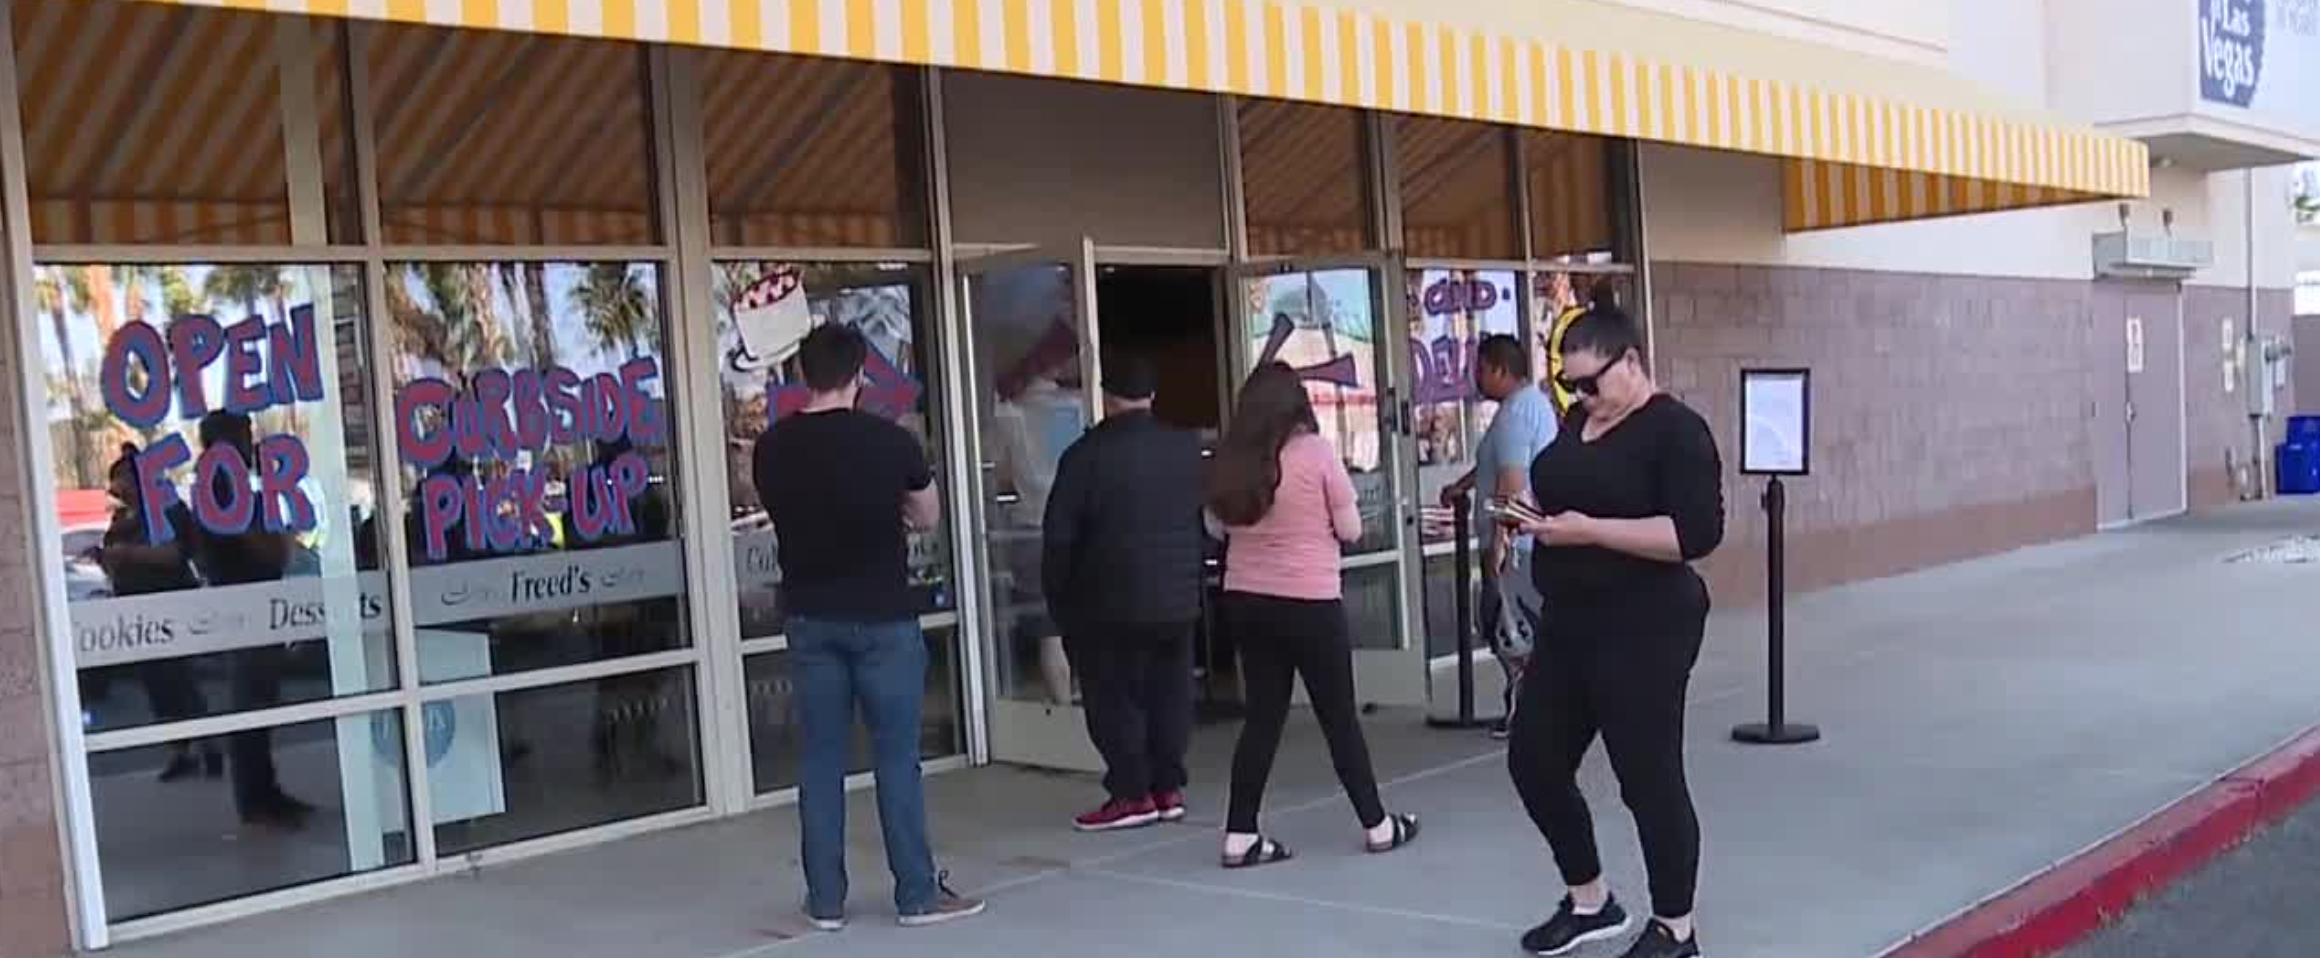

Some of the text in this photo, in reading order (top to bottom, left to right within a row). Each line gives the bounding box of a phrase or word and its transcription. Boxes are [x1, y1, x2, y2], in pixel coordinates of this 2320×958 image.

[2201, 16, 2255, 99] Vegas
[2222, 0, 2250, 37] Las
[101, 303, 325, 429] OPEN
[397, 355, 665, 468] CURBSIDE
[133, 432, 317, 546] FOR
[73, 590, 382, 653] ookies Dessts
[510, 562, 592, 603] Freed's
